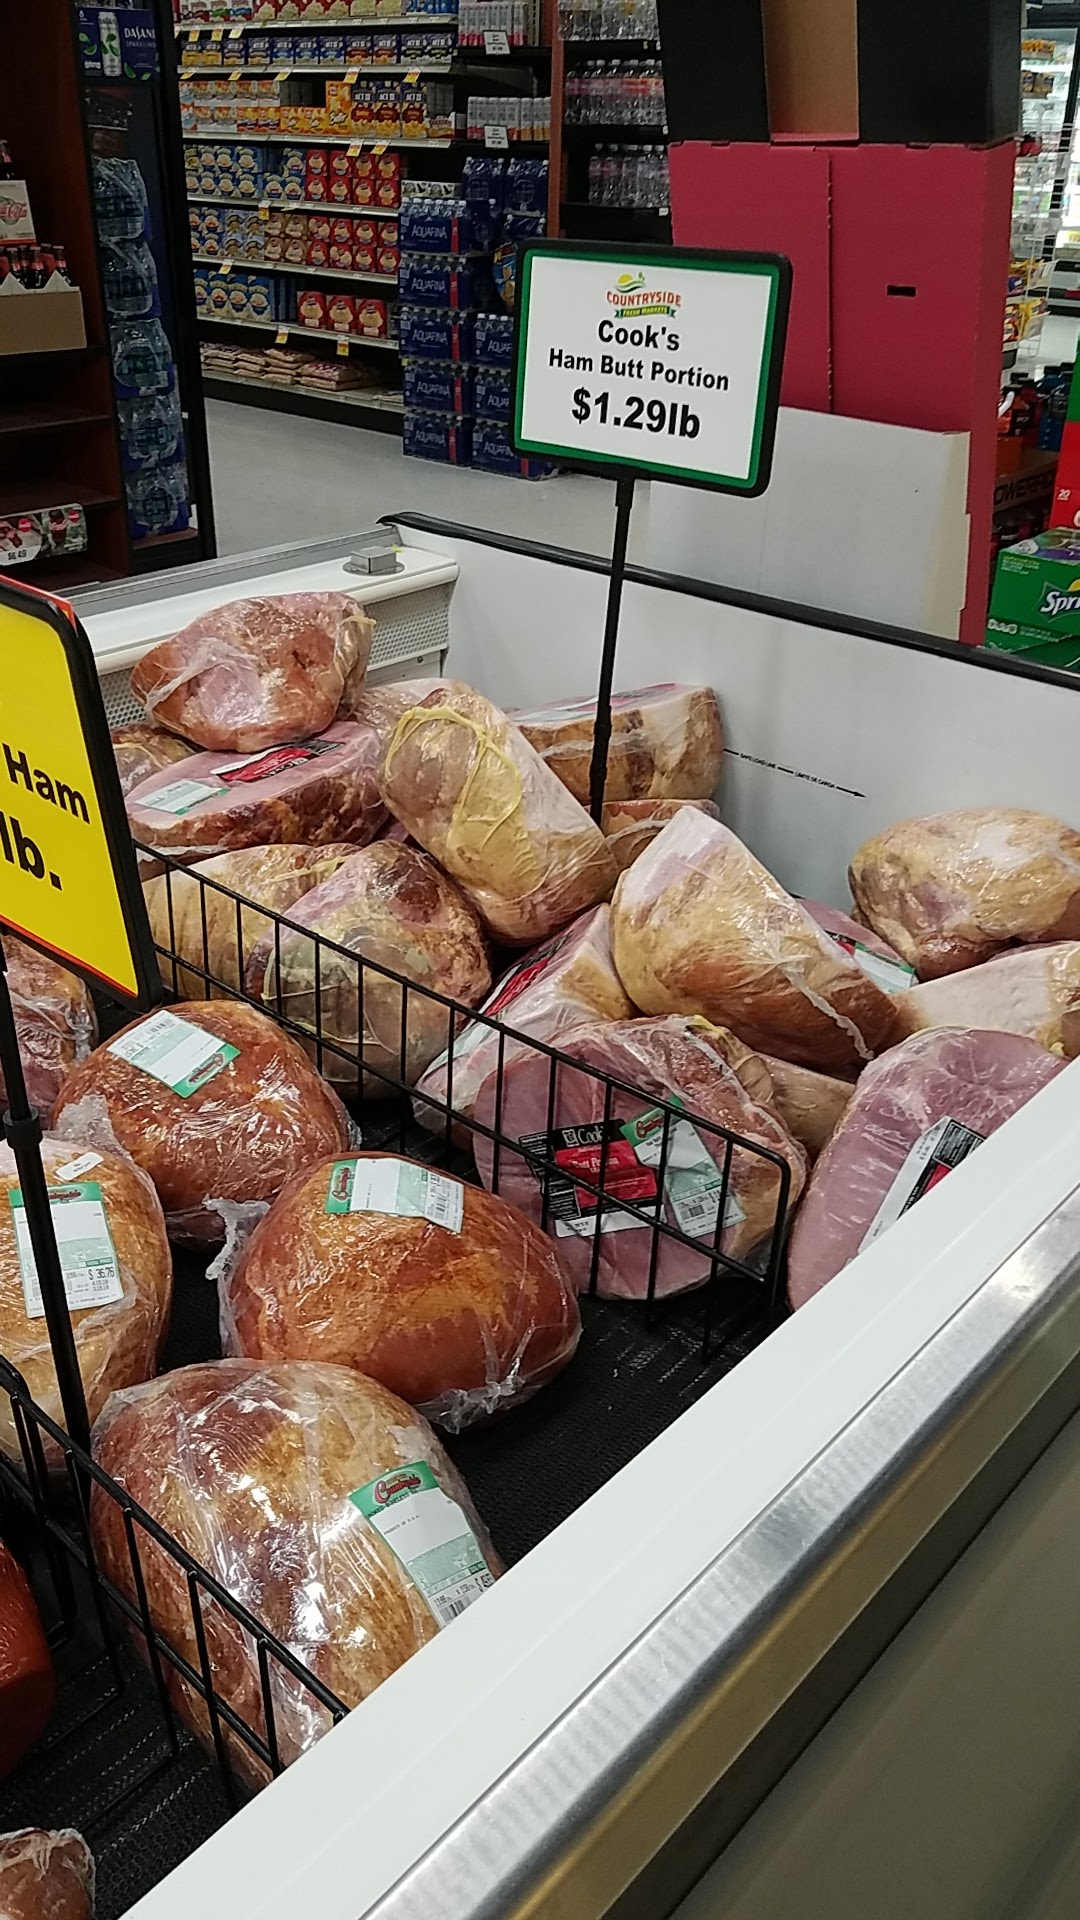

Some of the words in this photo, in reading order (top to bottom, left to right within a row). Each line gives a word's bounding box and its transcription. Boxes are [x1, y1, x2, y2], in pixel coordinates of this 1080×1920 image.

[411, 225, 448, 239] AQUAFINA
[411, 278, 447, 294] AQUAFINA
[606, 290, 682, 307] COUNTRYSIDE
[412, 328, 448, 345] AQUAFINA
[598, 320, 680, 351] Cook's
[548, 348, 593, 372] Ham
[600, 355, 644, 380] Butt
[650, 362, 729, 391] Portion
[416, 381, 450, 398] AQUAFINA
[572, 387, 701, 439] $1.29lb
[2, 743, 90, 824] Ham
[88, 1269, 94, 1280] $
